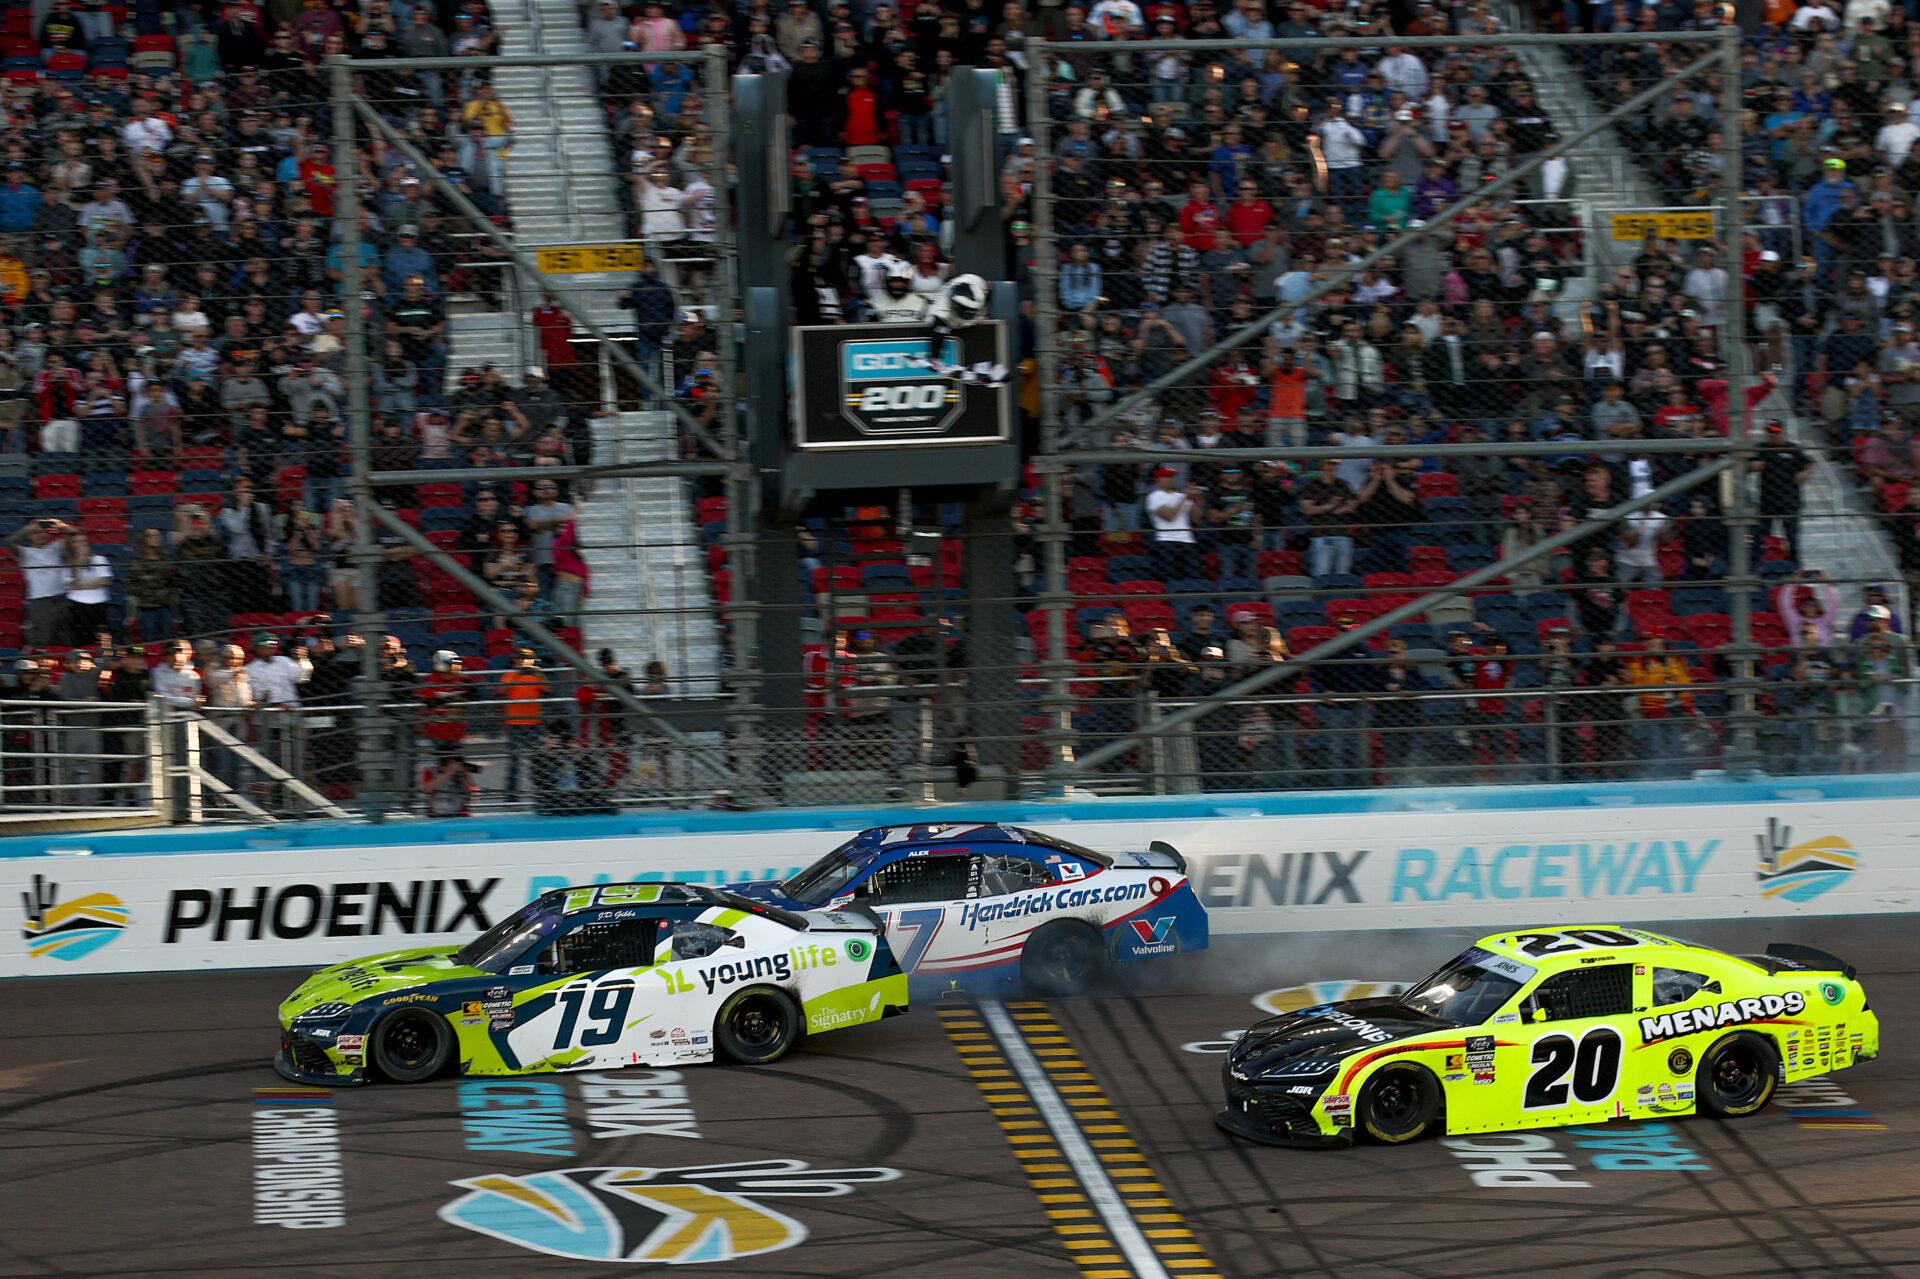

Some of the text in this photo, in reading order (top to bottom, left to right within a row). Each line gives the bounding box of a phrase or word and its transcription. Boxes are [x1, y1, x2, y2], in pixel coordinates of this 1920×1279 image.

[860, 385, 945, 411] 200
[1190, 839, 1724, 910] ENIX RACEWAY
[163, 878, 502, 944] PHOENIX
[615, 910, 636, 919] Gibbs
[1132, 944, 1175, 955] Valvoline
[1493, 929, 1644, 961] 20
[383, 994, 439, 1006] GOODYEAR
[483, 1001, 512, 1009] COMETIC
[821, 1007, 837, 1015] The
[553, 978, 637, 1050] 19
[810, 1007, 867, 1029] Signatry
[1640, 991, 1806, 1044] MENARDS
[312, 1028, 331, 1036] JGR
[1466, 1053, 1494, 1061] COMETIC
[1522, 1025, 1625, 1111] 20
[1286, 1086, 1314, 1095] JGR
[251, 1107, 346, 1229] CHAMPIONSHIP
